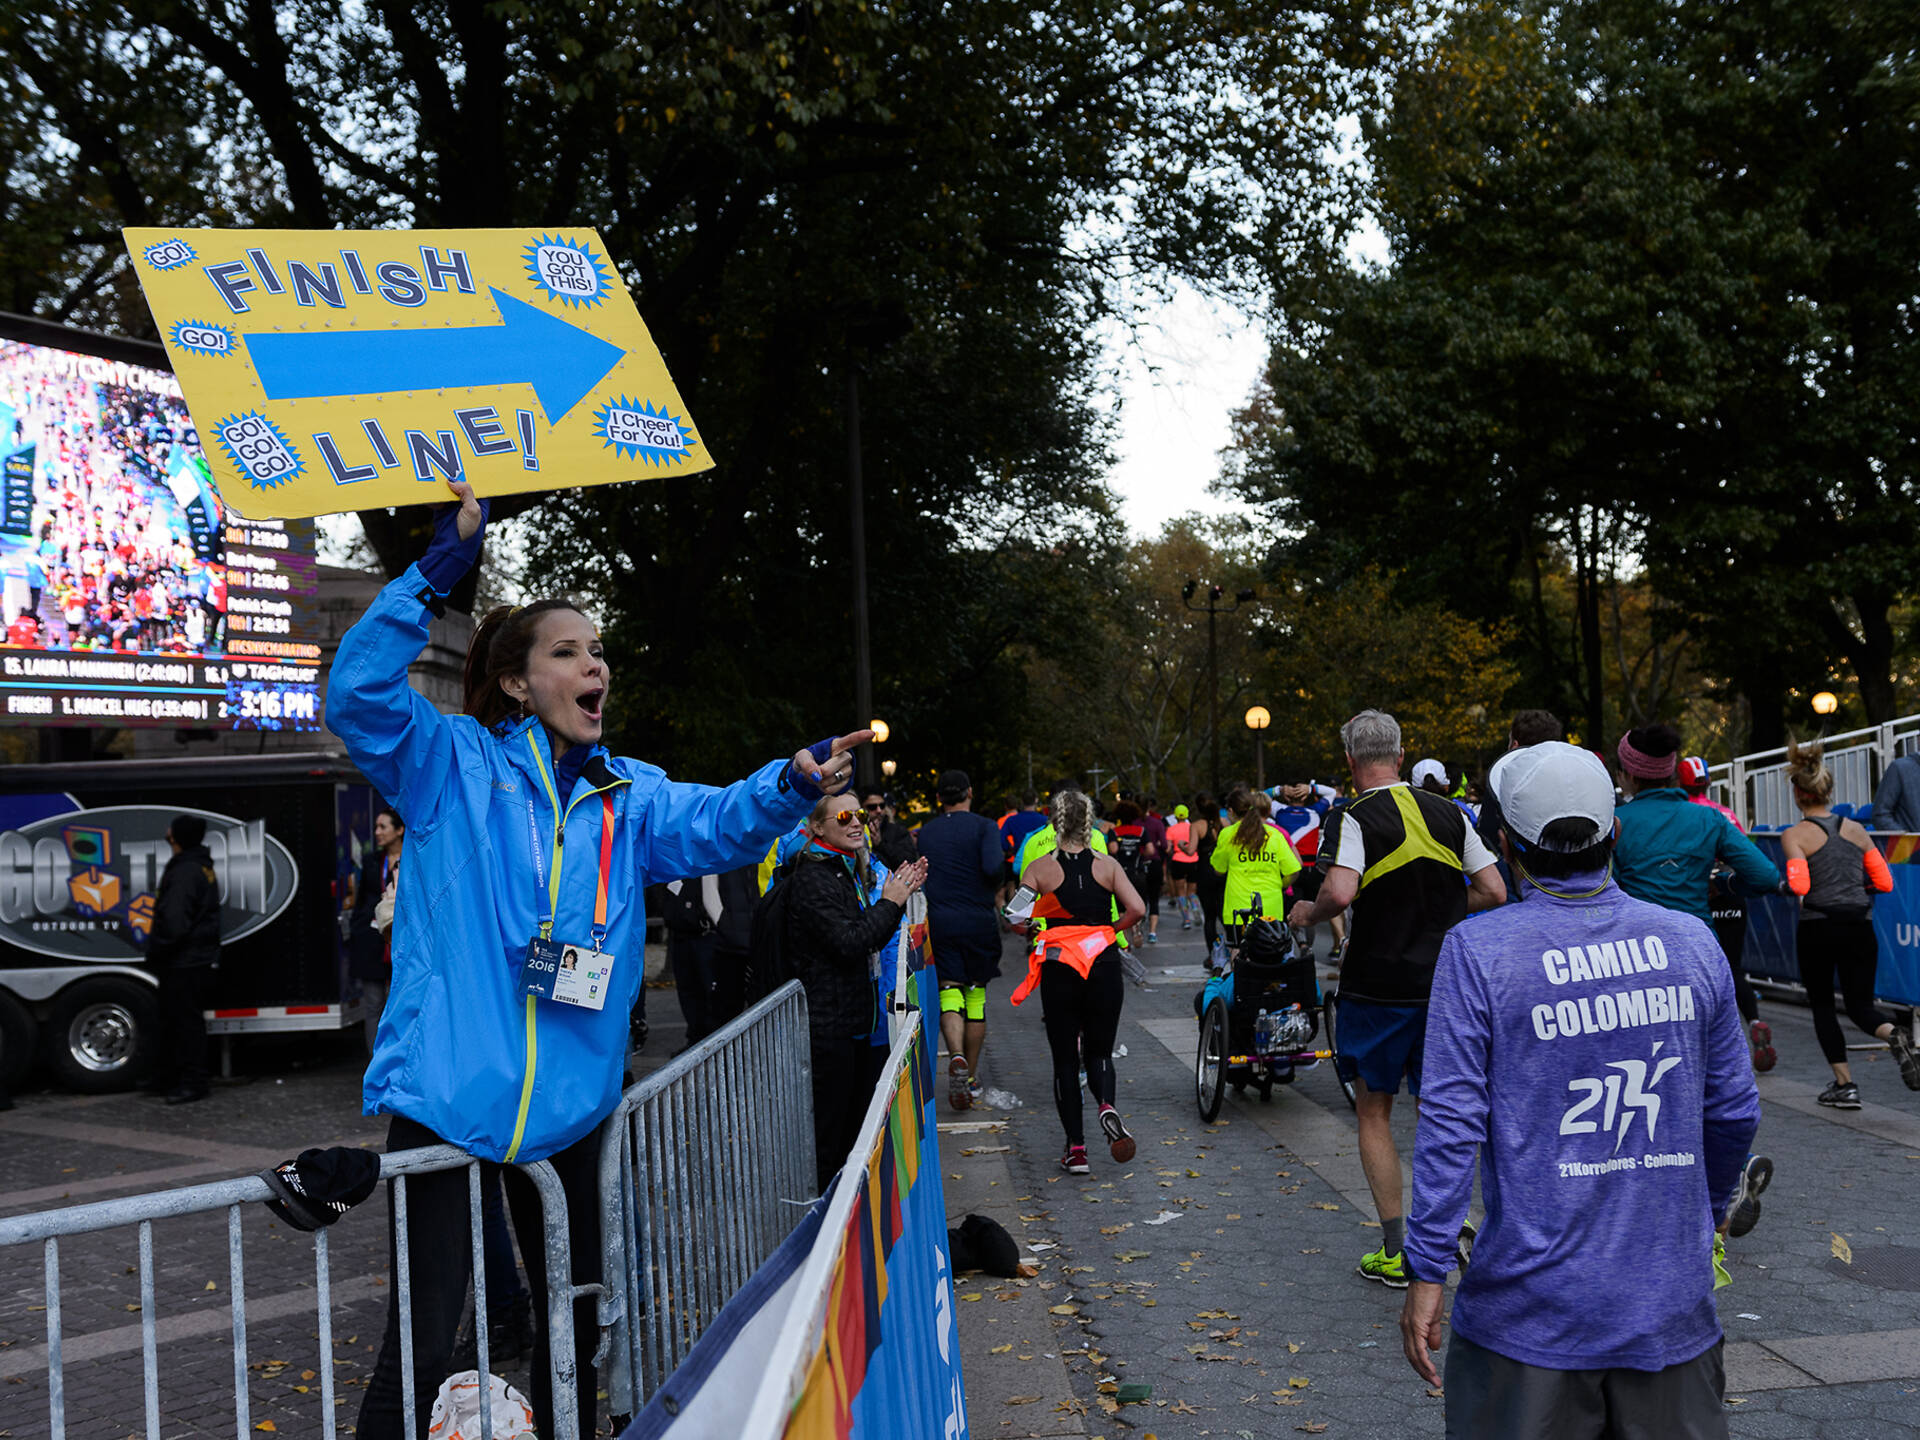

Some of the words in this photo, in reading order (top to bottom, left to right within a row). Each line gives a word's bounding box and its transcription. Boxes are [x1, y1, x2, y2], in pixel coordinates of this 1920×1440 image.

[150, 243, 190, 267] GO!
[543, 249, 583, 266] YOU
[203, 246, 476, 313] FINISH
[546, 274, 593, 291] THIS!
[547, 263, 586, 278] GOT
[182, 329, 224, 349] GO!
[225, 418, 267, 443] GO!
[613, 411, 618, 425] I
[622, 412, 673, 433] Cheer
[238, 436, 280, 460] GO!
[312, 405, 540, 486] LINE!
[609, 425, 639, 442] For
[642, 428, 681, 447] You!
[252, 454, 294, 479] GO!
[241, 691, 281, 718] 3:16
[284, 693, 313, 718] PM
[1238, 850, 1278, 863] GUIDE
[103, 920, 120, 931] TV
[528, 958, 555, 973] 2016
[1542, 935, 1668, 984] CAMILO
[1531, 985, 1695, 1041] COLOMBIA
[1559, 1154, 1636, 1178] 21Korredores
[1644, 1152, 1695, 1170] Colombia
